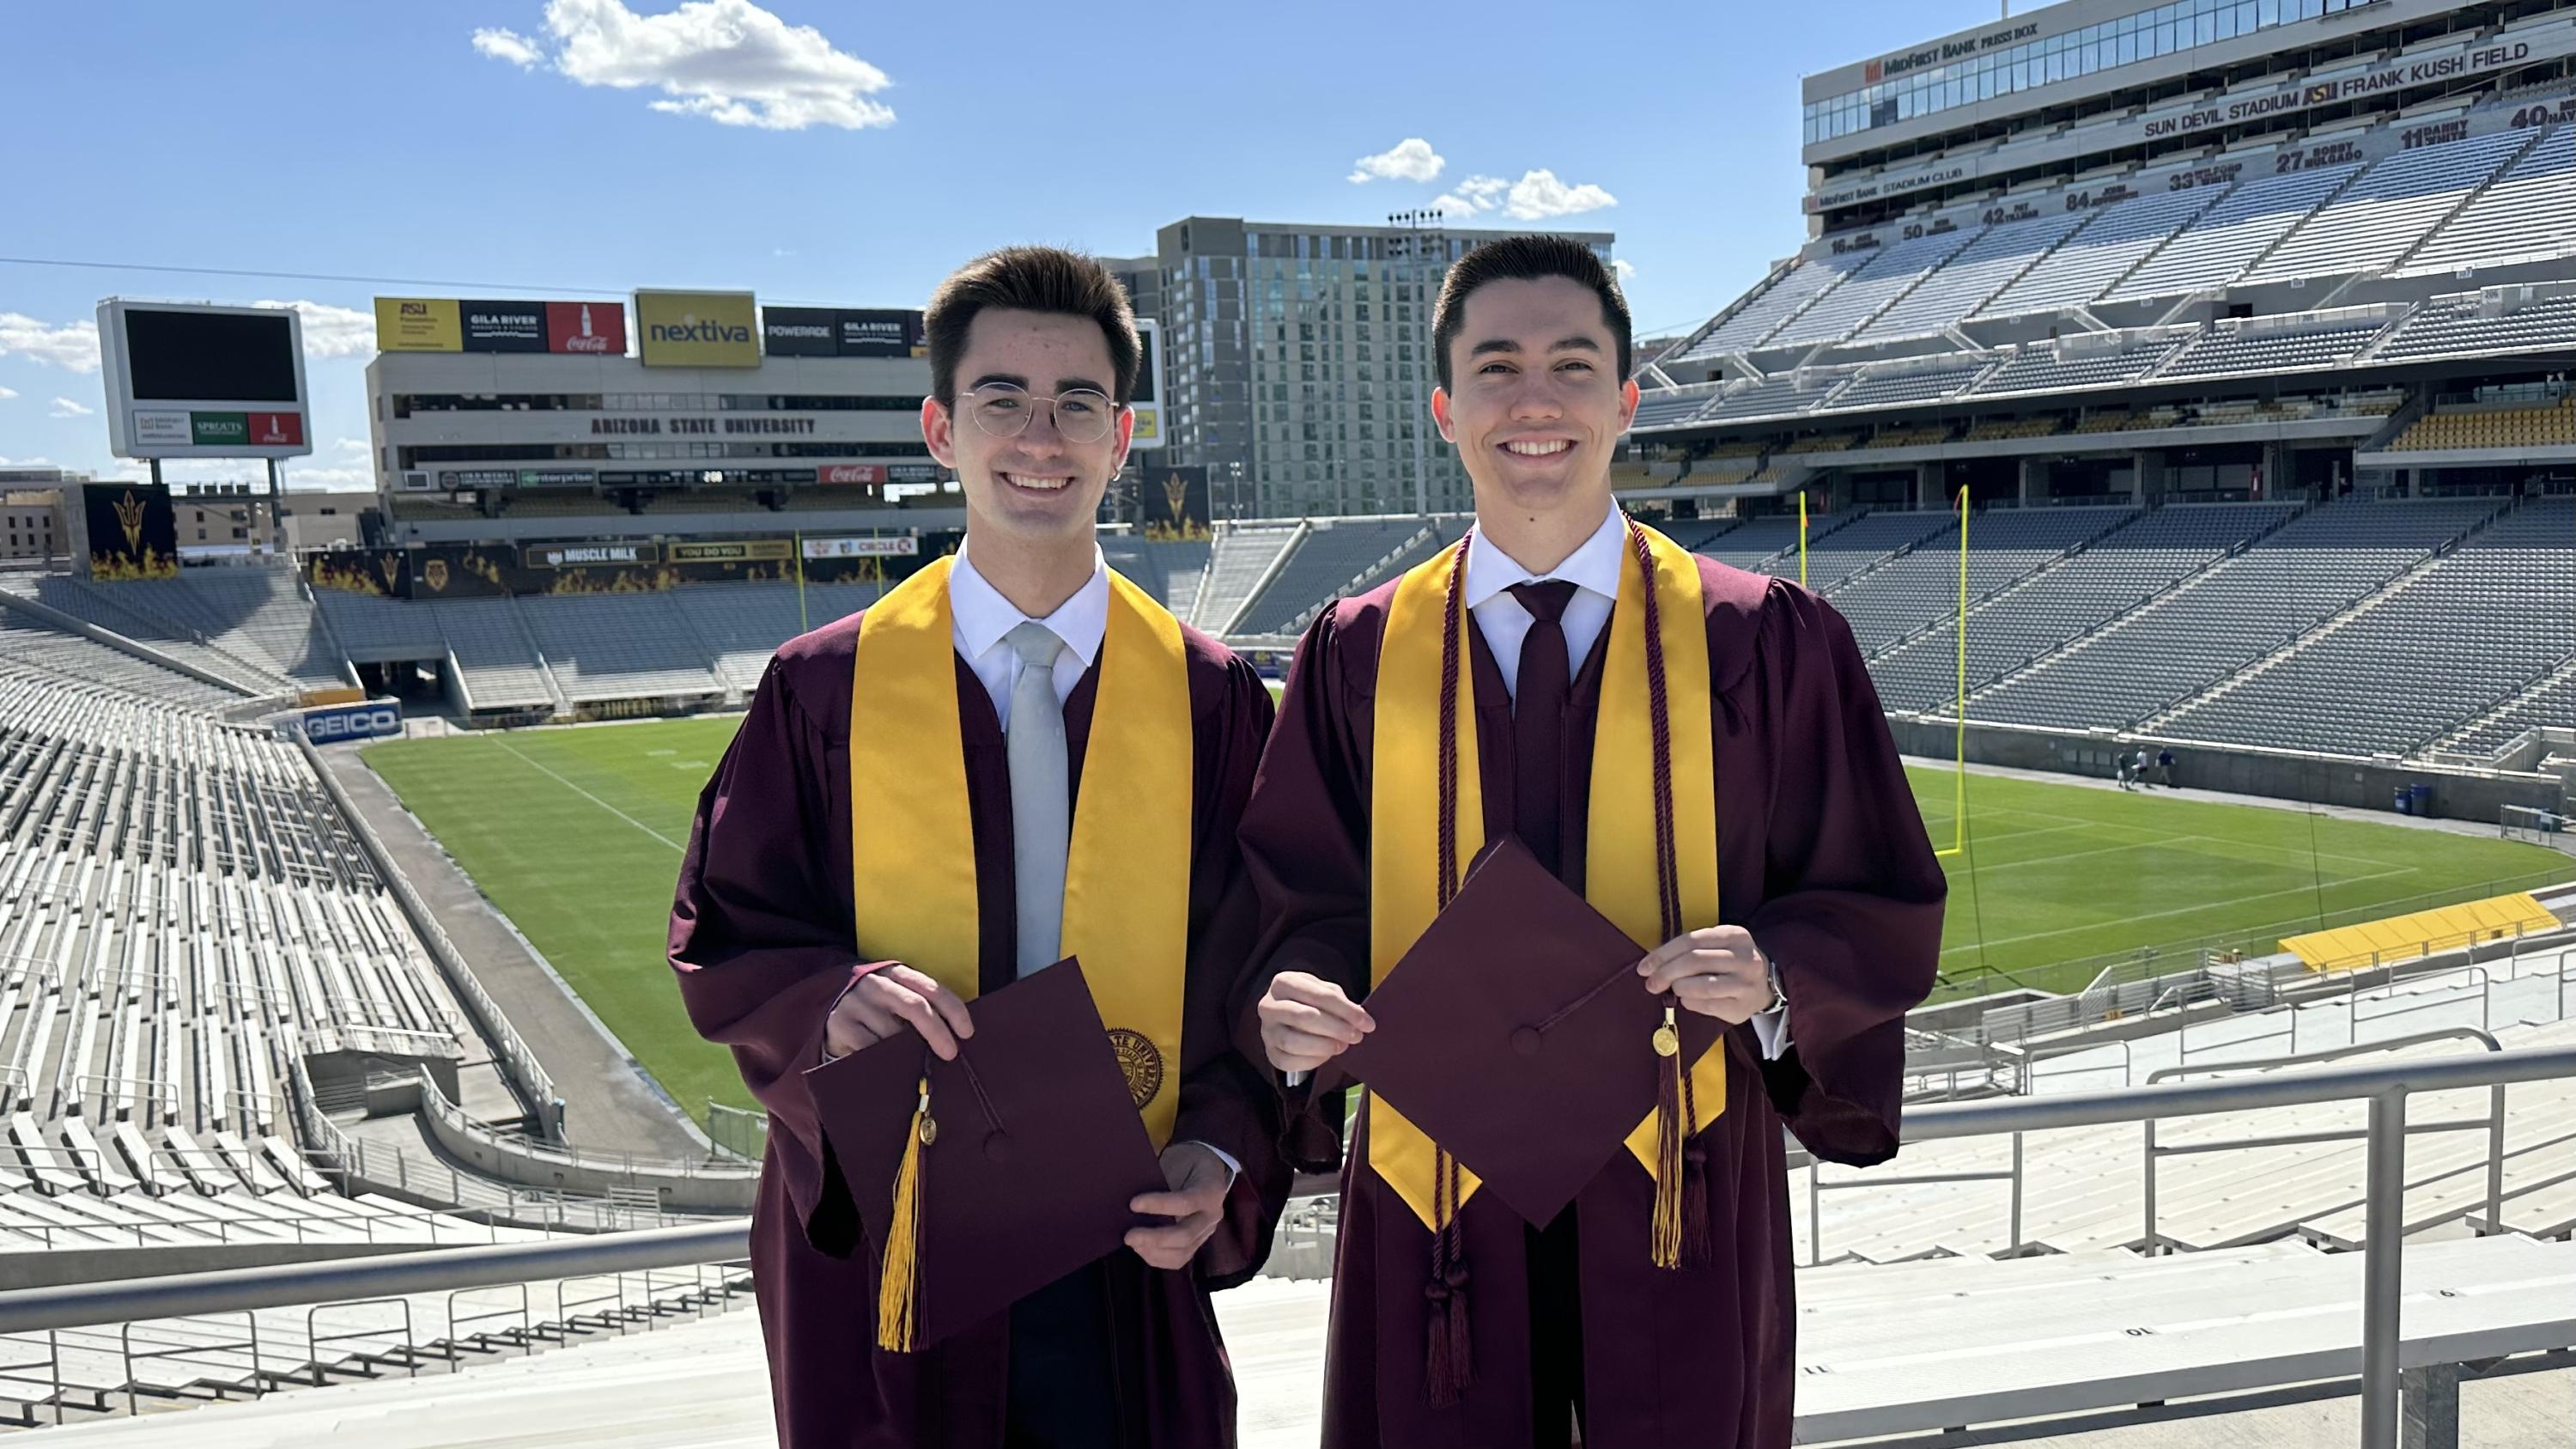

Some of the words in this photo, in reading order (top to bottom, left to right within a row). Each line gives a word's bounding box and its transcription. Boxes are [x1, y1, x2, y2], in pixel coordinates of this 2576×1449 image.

[1942, 39, 1977, 59] BANK
[1981, 30, 2013, 49] PRESS
[2014, 22, 2038, 40] BOX
[2144, 119, 2176, 137] SUN
[2182, 109, 2224, 131] DEVIL
[2229, 91, 2299, 119] STADIUM
[2301, 82, 2338, 105] ASU
[2342, 68, 2405, 96] FRANK
[2410, 55, 2464, 82] KUSH
[2472, 42, 2529, 69] FIELD
[2510, 105, 2549, 129] 40
[2423, 119, 2469, 137] DANNY
[2400, 128, 2423, 149] 11
[2312, 141, 2354, 156] BOBBY
[2276, 150, 2304, 173] 27
[1856, 186, 1878, 200] BANK
[1883, 175, 1930, 193] STADIUM
[1932, 167, 1963, 183] CLUB
[2169, 174, 2194, 192] 33
[2065, 191, 2090, 211] 84
[1982, 207, 2005, 225] 42
[1903, 223, 1923, 240] 50
[1831, 238, 1846, 254] 16
[400, 302, 427, 315] ASU
[471, 314, 499, 325] GILA
[501, 315, 538, 326] RIVER
[843, 321, 867, 332] GILA
[868, 322, 901, 332] RIVER
[650, 319, 750, 343] nextiva
[768, 326, 829, 338] POWERADE
[566, 336, 608, 350] Coca-Cola
[196, 421, 243, 431] SPROUTS
[591, 418, 661, 435] ARIZONA
[670, 418, 717, 435] STATE
[725, 418, 815, 435] UNIVERSITY
[829, 466, 874, 484] Coca-Cola
[565, 548, 609, 562] MUSCLE
[610, 546, 637, 561] MILK
[680, 547, 702, 558] YOU
[703, 547, 720, 557] DO
[720, 545, 742, 557] YOU
[307, 709, 396, 738] GEICO
[2125, 1326, 2154, 1336] 10
